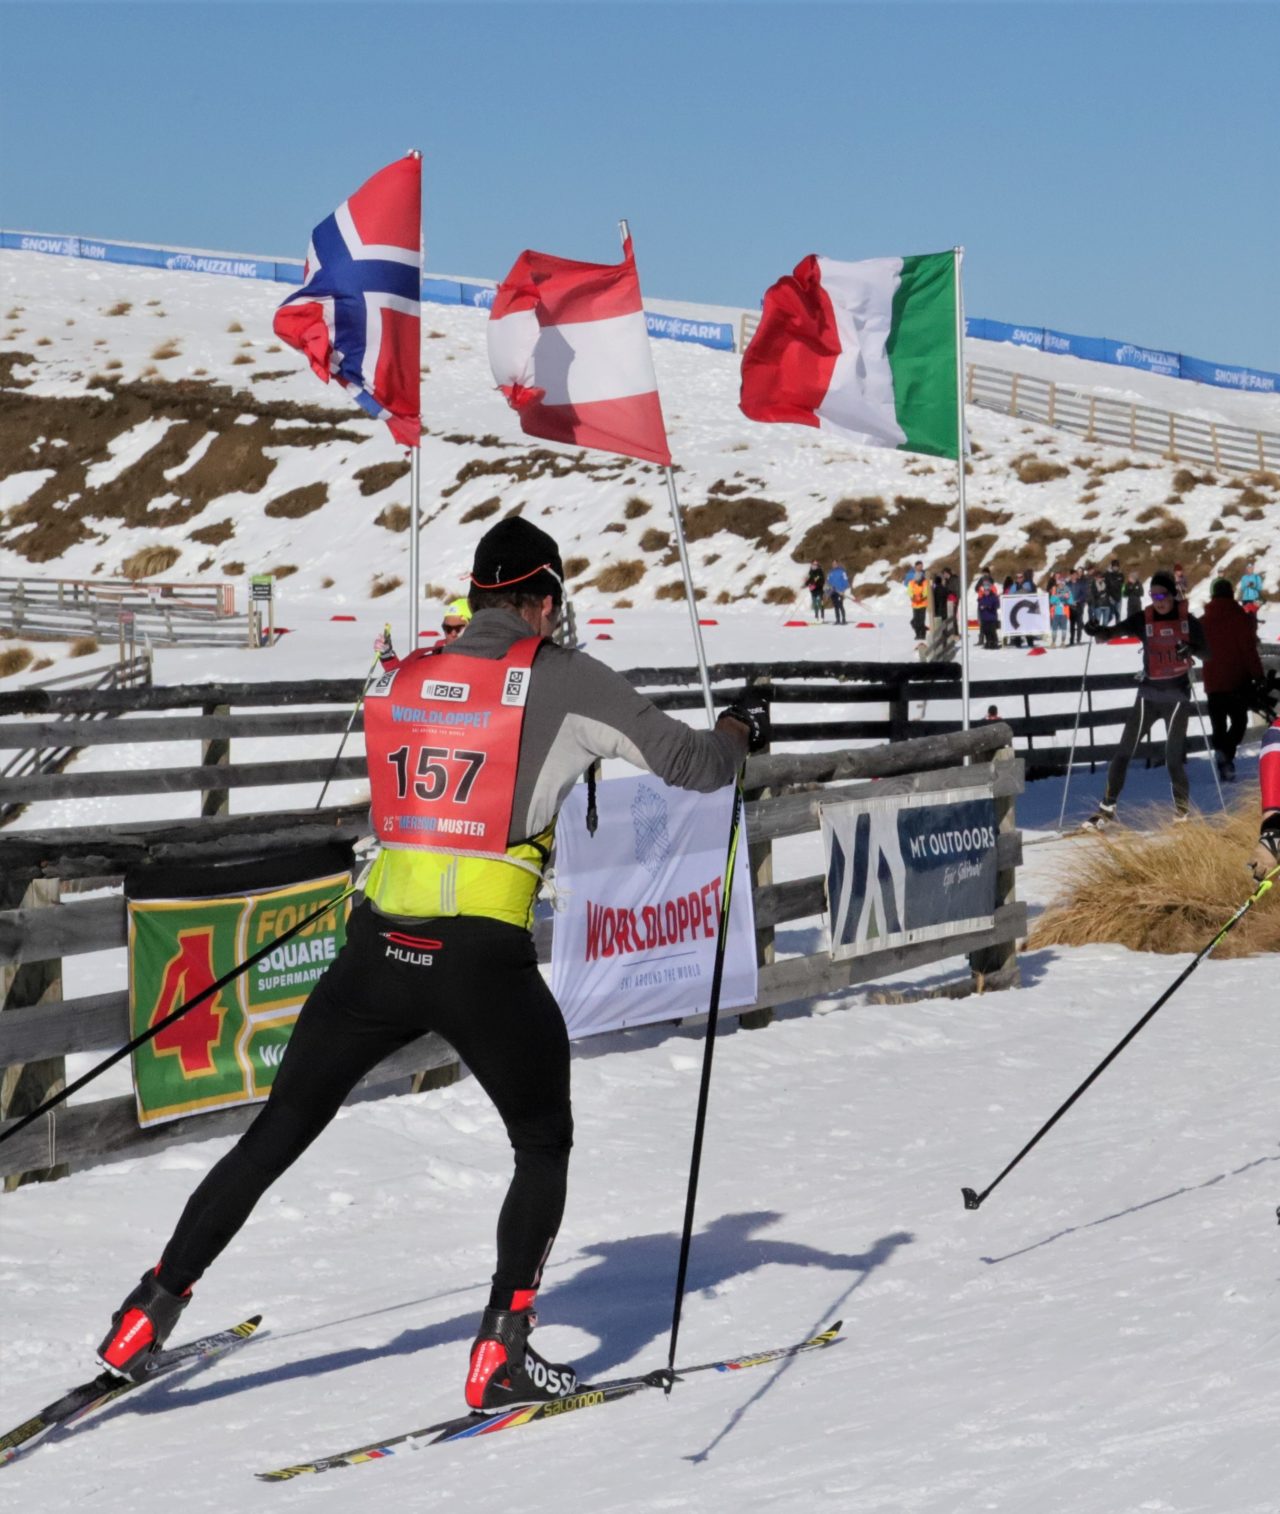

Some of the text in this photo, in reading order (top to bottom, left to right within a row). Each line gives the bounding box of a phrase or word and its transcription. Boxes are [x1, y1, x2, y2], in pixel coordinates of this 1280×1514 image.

[22, 238, 61, 253] SNOW
[196, 259, 257, 277] PUZZLING
[647, 318, 721, 340] OW FARM
[1012, 329, 1042, 345] SNOW
[1215, 369, 1274, 389] SNOW FARM
[391, 704, 491, 729] WORLDLOPPET
[387, 746, 487, 804] 157
[437, 818, 486, 836] MUSTER
[909, 826, 995, 859] MT OUTDOORS
[256, 899, 337, 944] FOUR
[585, 876, 723, 962] WORLDLOPPET
[258, 937, 336, 973] SQUARE
[385, 945, 433, 966] HUUB
[149, 926, 228, 1080] 4
